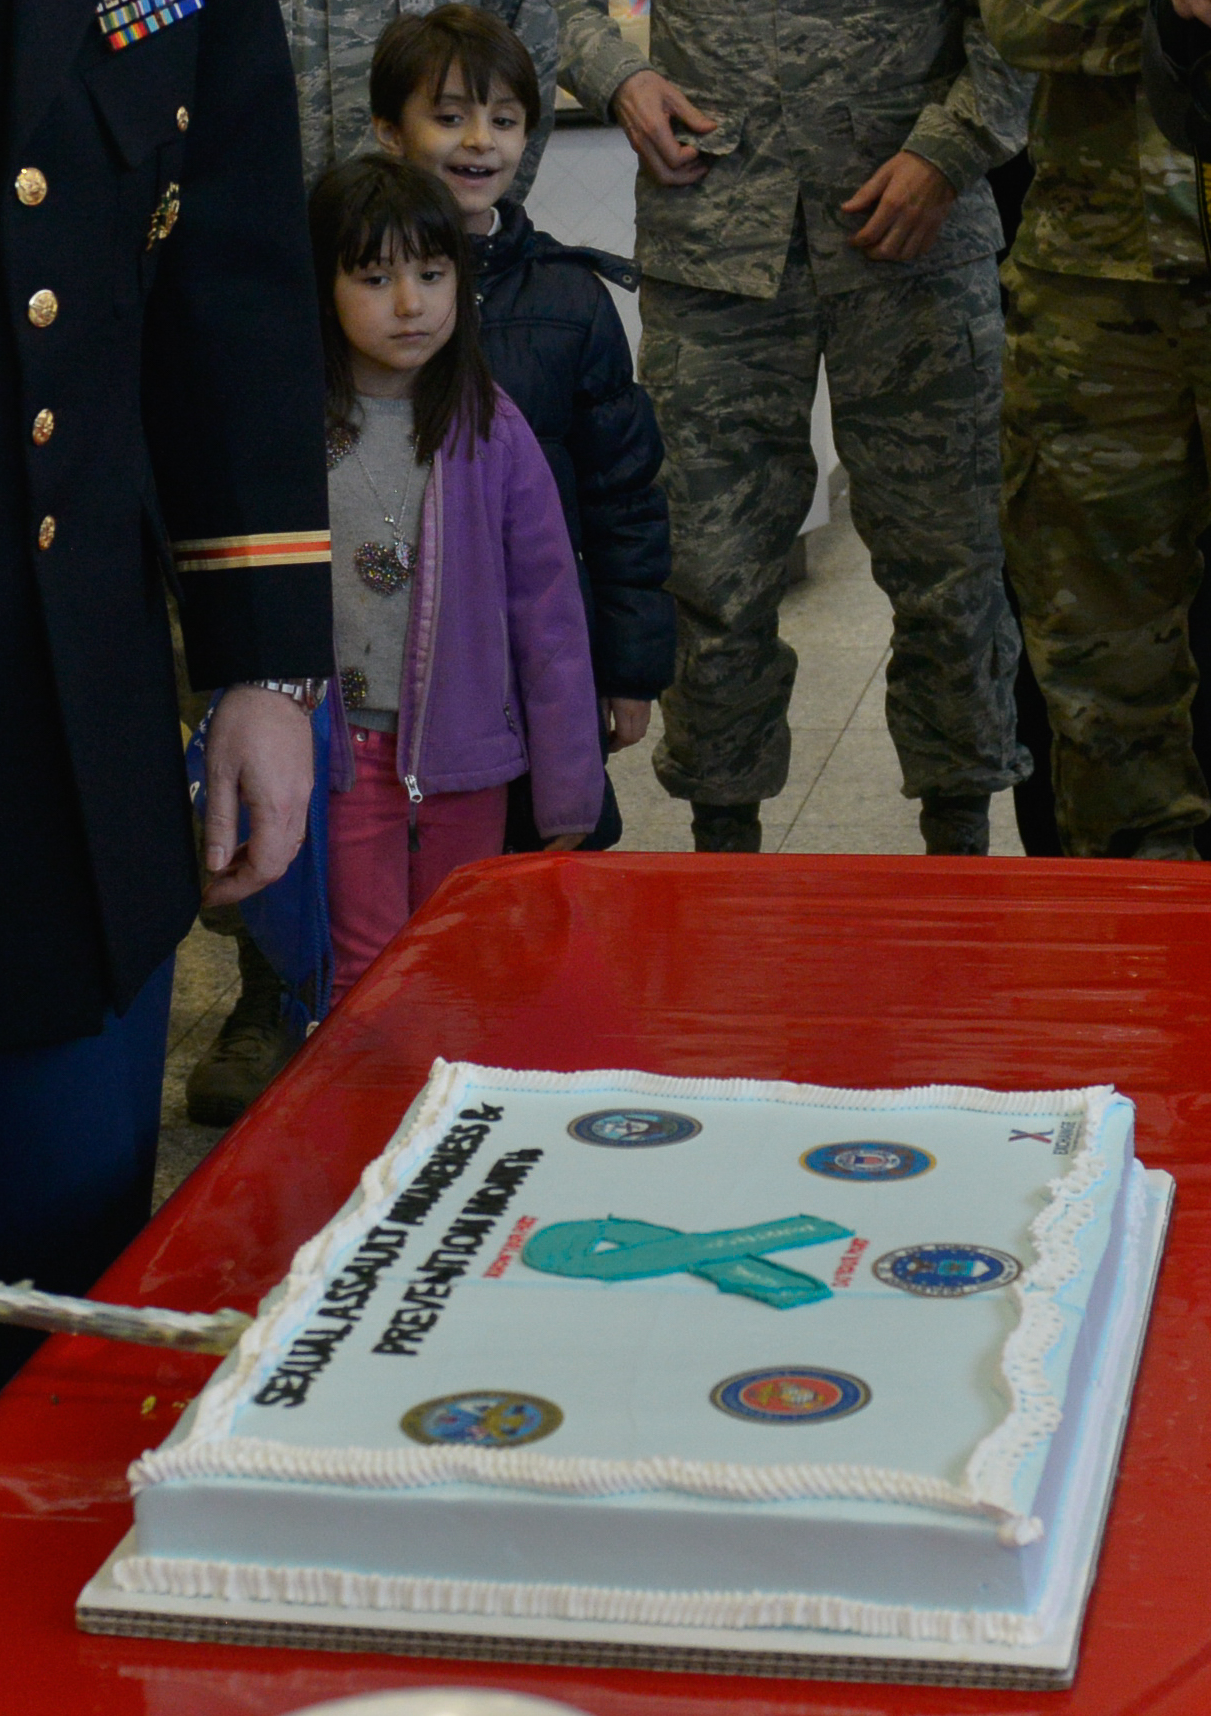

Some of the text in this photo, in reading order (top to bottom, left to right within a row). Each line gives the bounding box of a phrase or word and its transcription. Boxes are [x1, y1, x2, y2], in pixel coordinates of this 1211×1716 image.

[253, 1323, 354, 1408] SEXUAL
[317, 1225, 408, 1322] ASSAULT
[459, 1101, 505, 1122] &
[372, 1217, 496, 1356] PREVENTION
